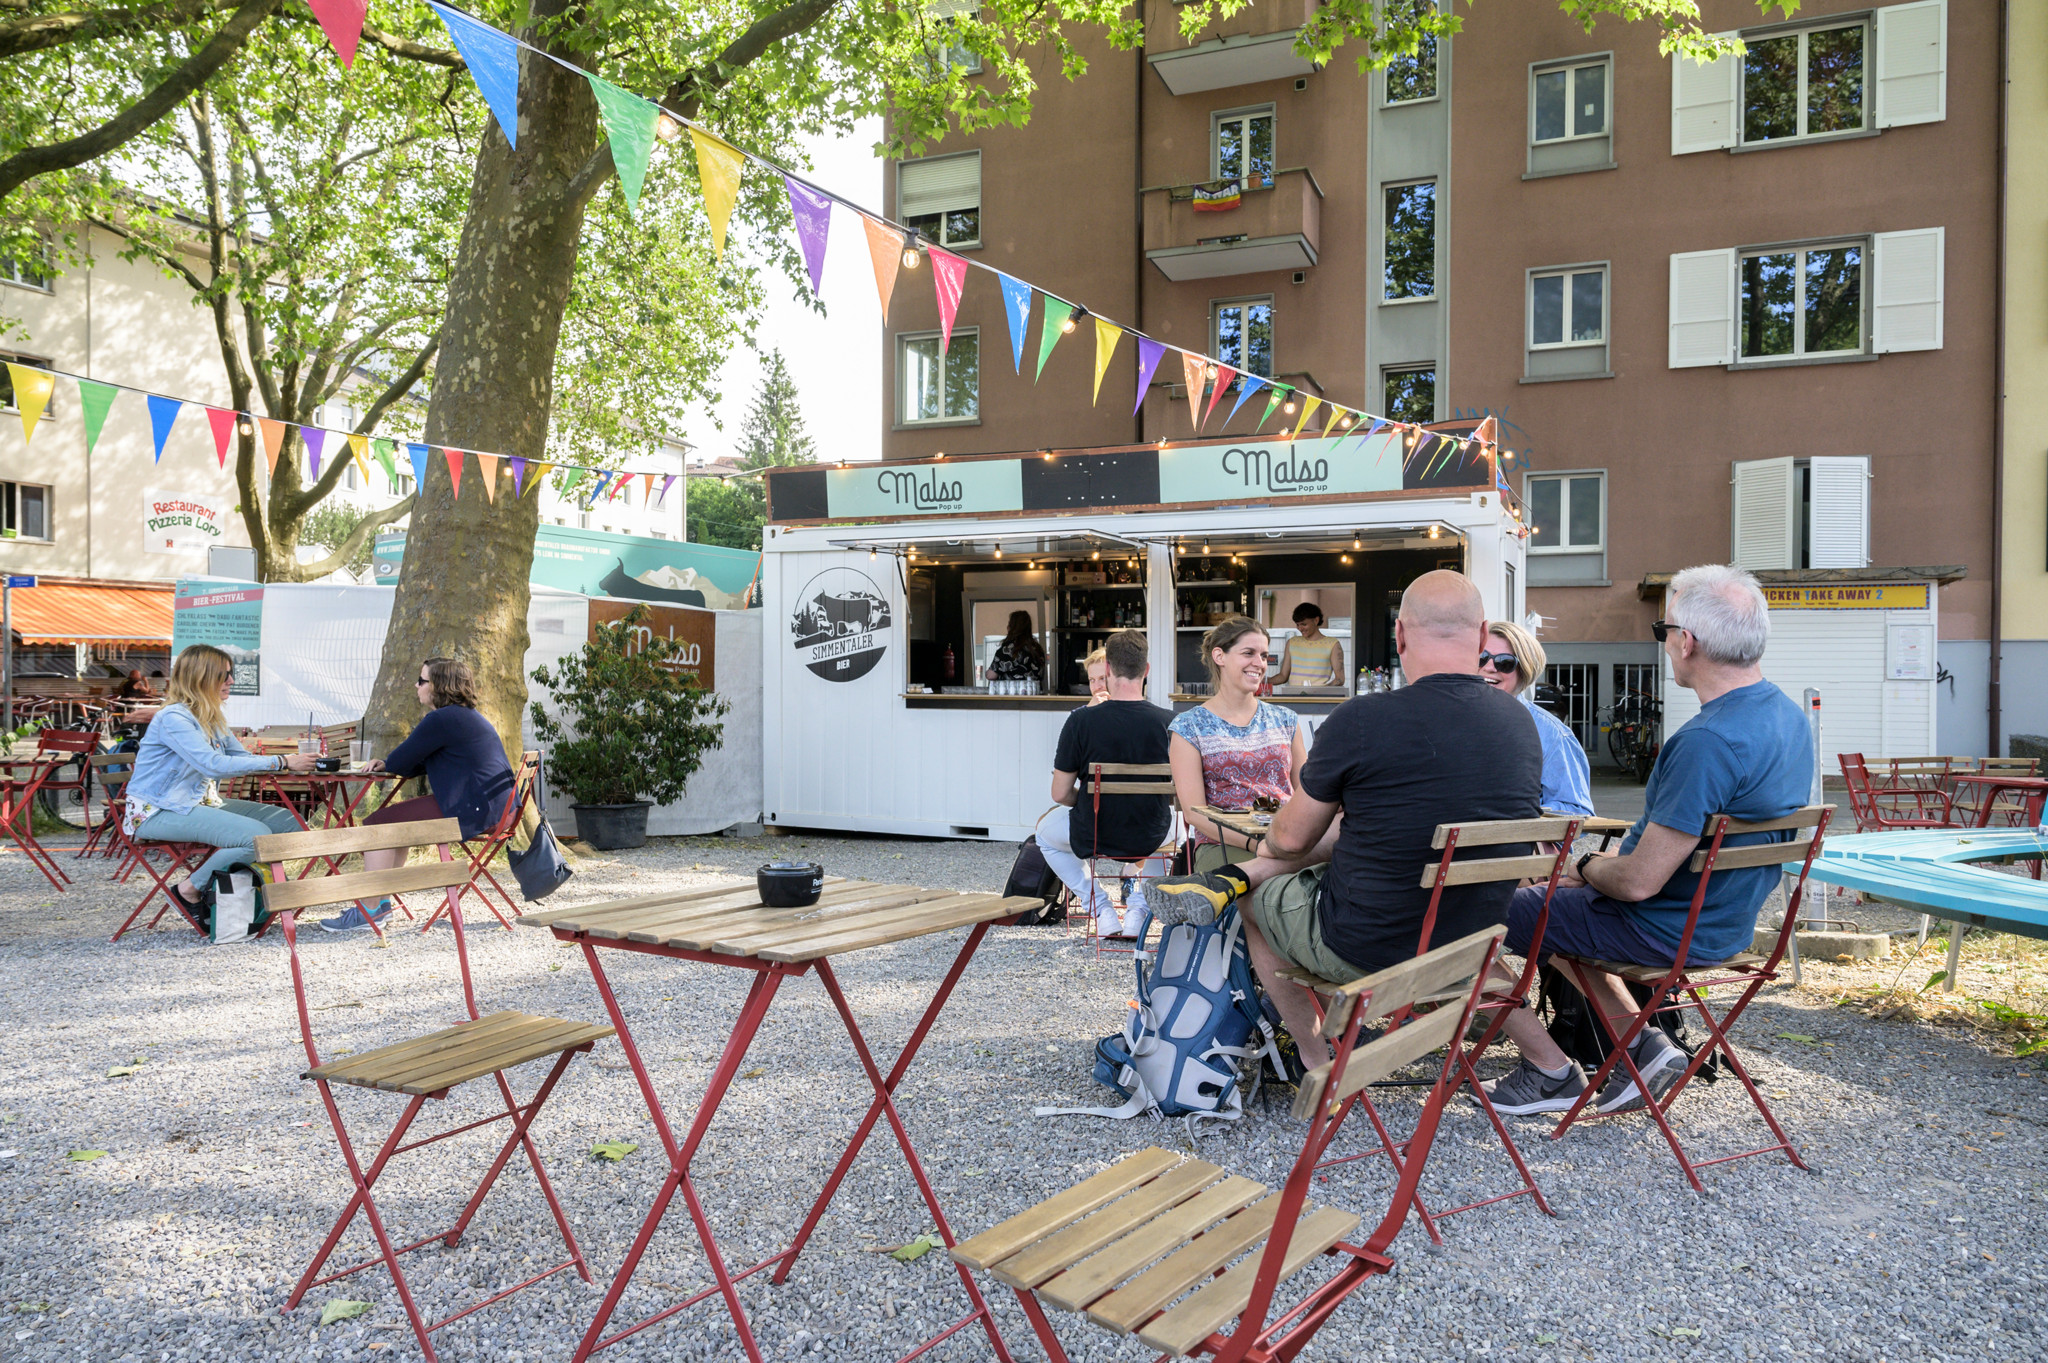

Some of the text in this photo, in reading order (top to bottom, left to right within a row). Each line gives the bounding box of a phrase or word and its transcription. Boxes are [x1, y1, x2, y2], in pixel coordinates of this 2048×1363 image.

[1194, 184, 1239, 200] NO WAR
[1222, 444, 1328, 493] Malso
[878, 467, 963, 510] Malso
[152, 500, 216, 521] Restaurant
[147, 513, 221, 536] Pizzeria Lory
[193, 592, 245, 606] BIER-FESTIVAL
[1761, 589, 1883, 600] ICKEN TAKE AWAY 2
[812, 634, 874, 660] SIMMENTALER
[836, 659, 850, 671] BIER
